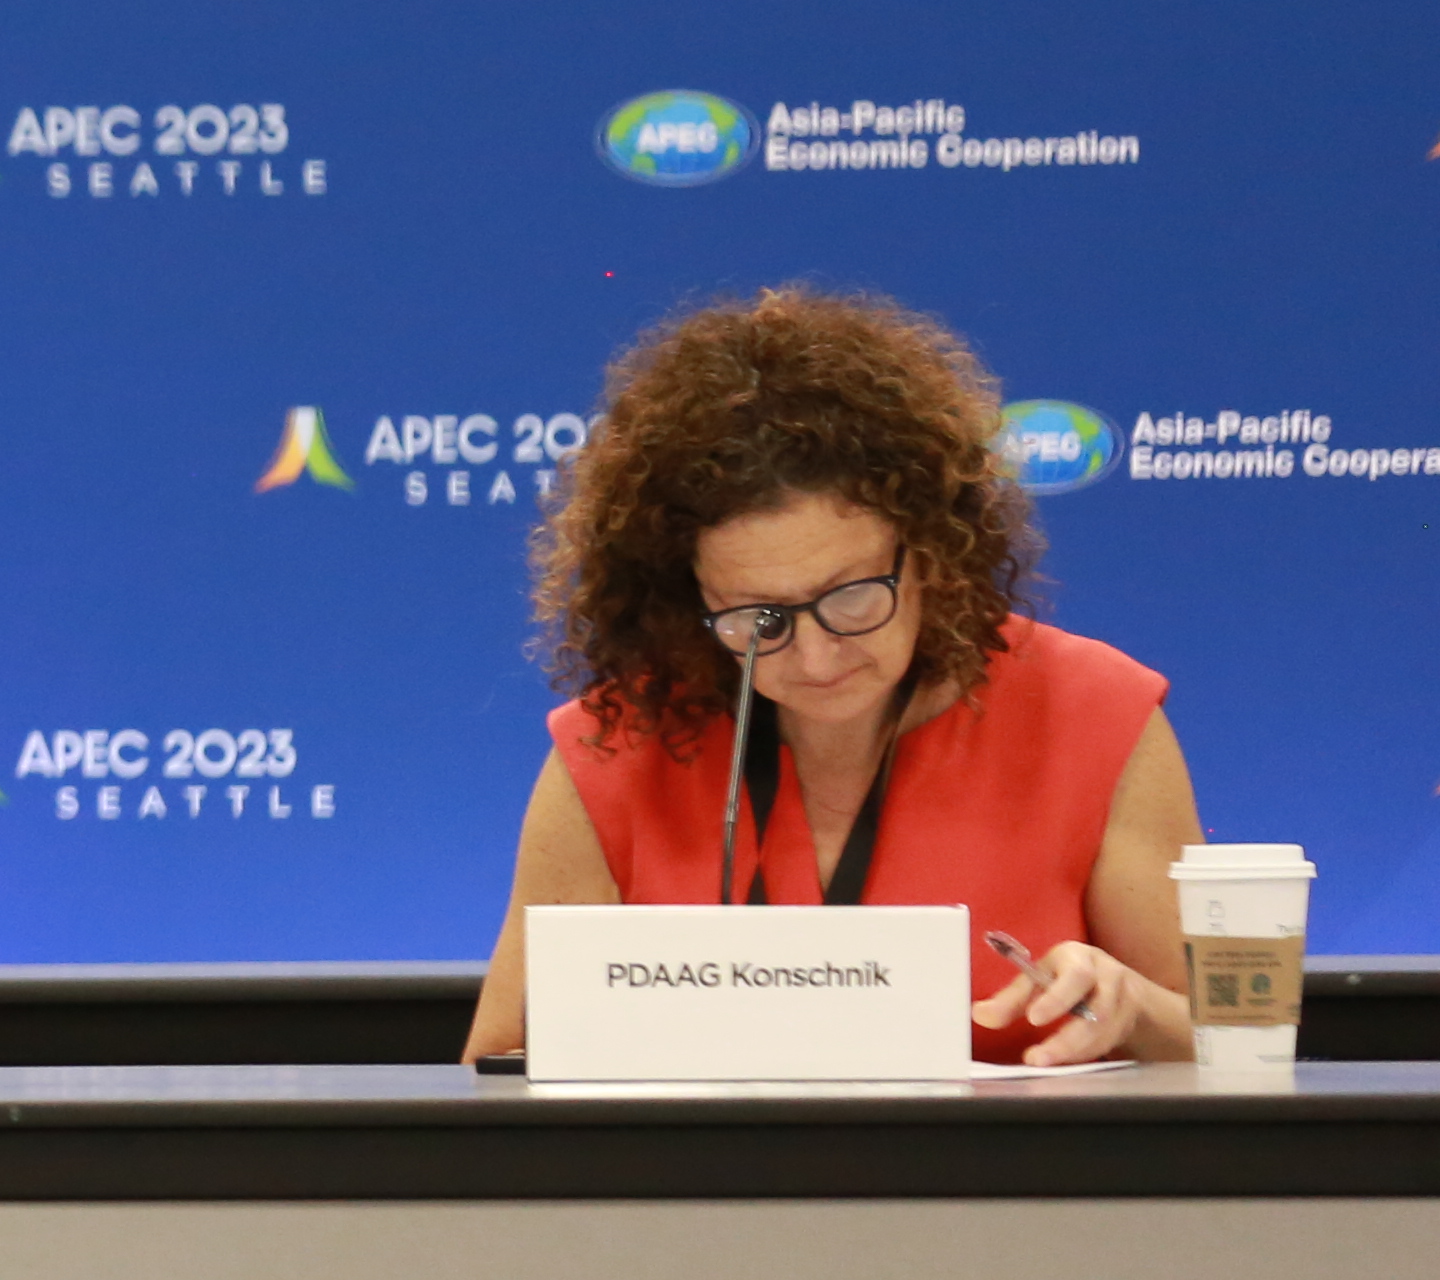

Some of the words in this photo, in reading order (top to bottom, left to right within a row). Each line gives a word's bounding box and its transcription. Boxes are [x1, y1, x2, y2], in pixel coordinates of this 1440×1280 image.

[8, 105, 140, 156] APEC
[155, 103, 290, 155] 2023
[767, 99, 966, 135] Asia-Pacific
[765, 135, 928, 171] Economic
[936, 128, 1141, 173] Cooperation
[48, 159, 326, 197] SEATTLE
[365, 413, 498, 465] APEC
[1130, 408, 1332, 445] Asia-Pacific
[1128, 443, 1295, 480] Economic
[16, 728, 149, 778] APEC
[163, 728, 298, 778] 2023
[56, 783, 335, 820] SEATTLE
[606, 961, 721, 988] PDAAG
[731, 959, 892, 988] Konschnik
